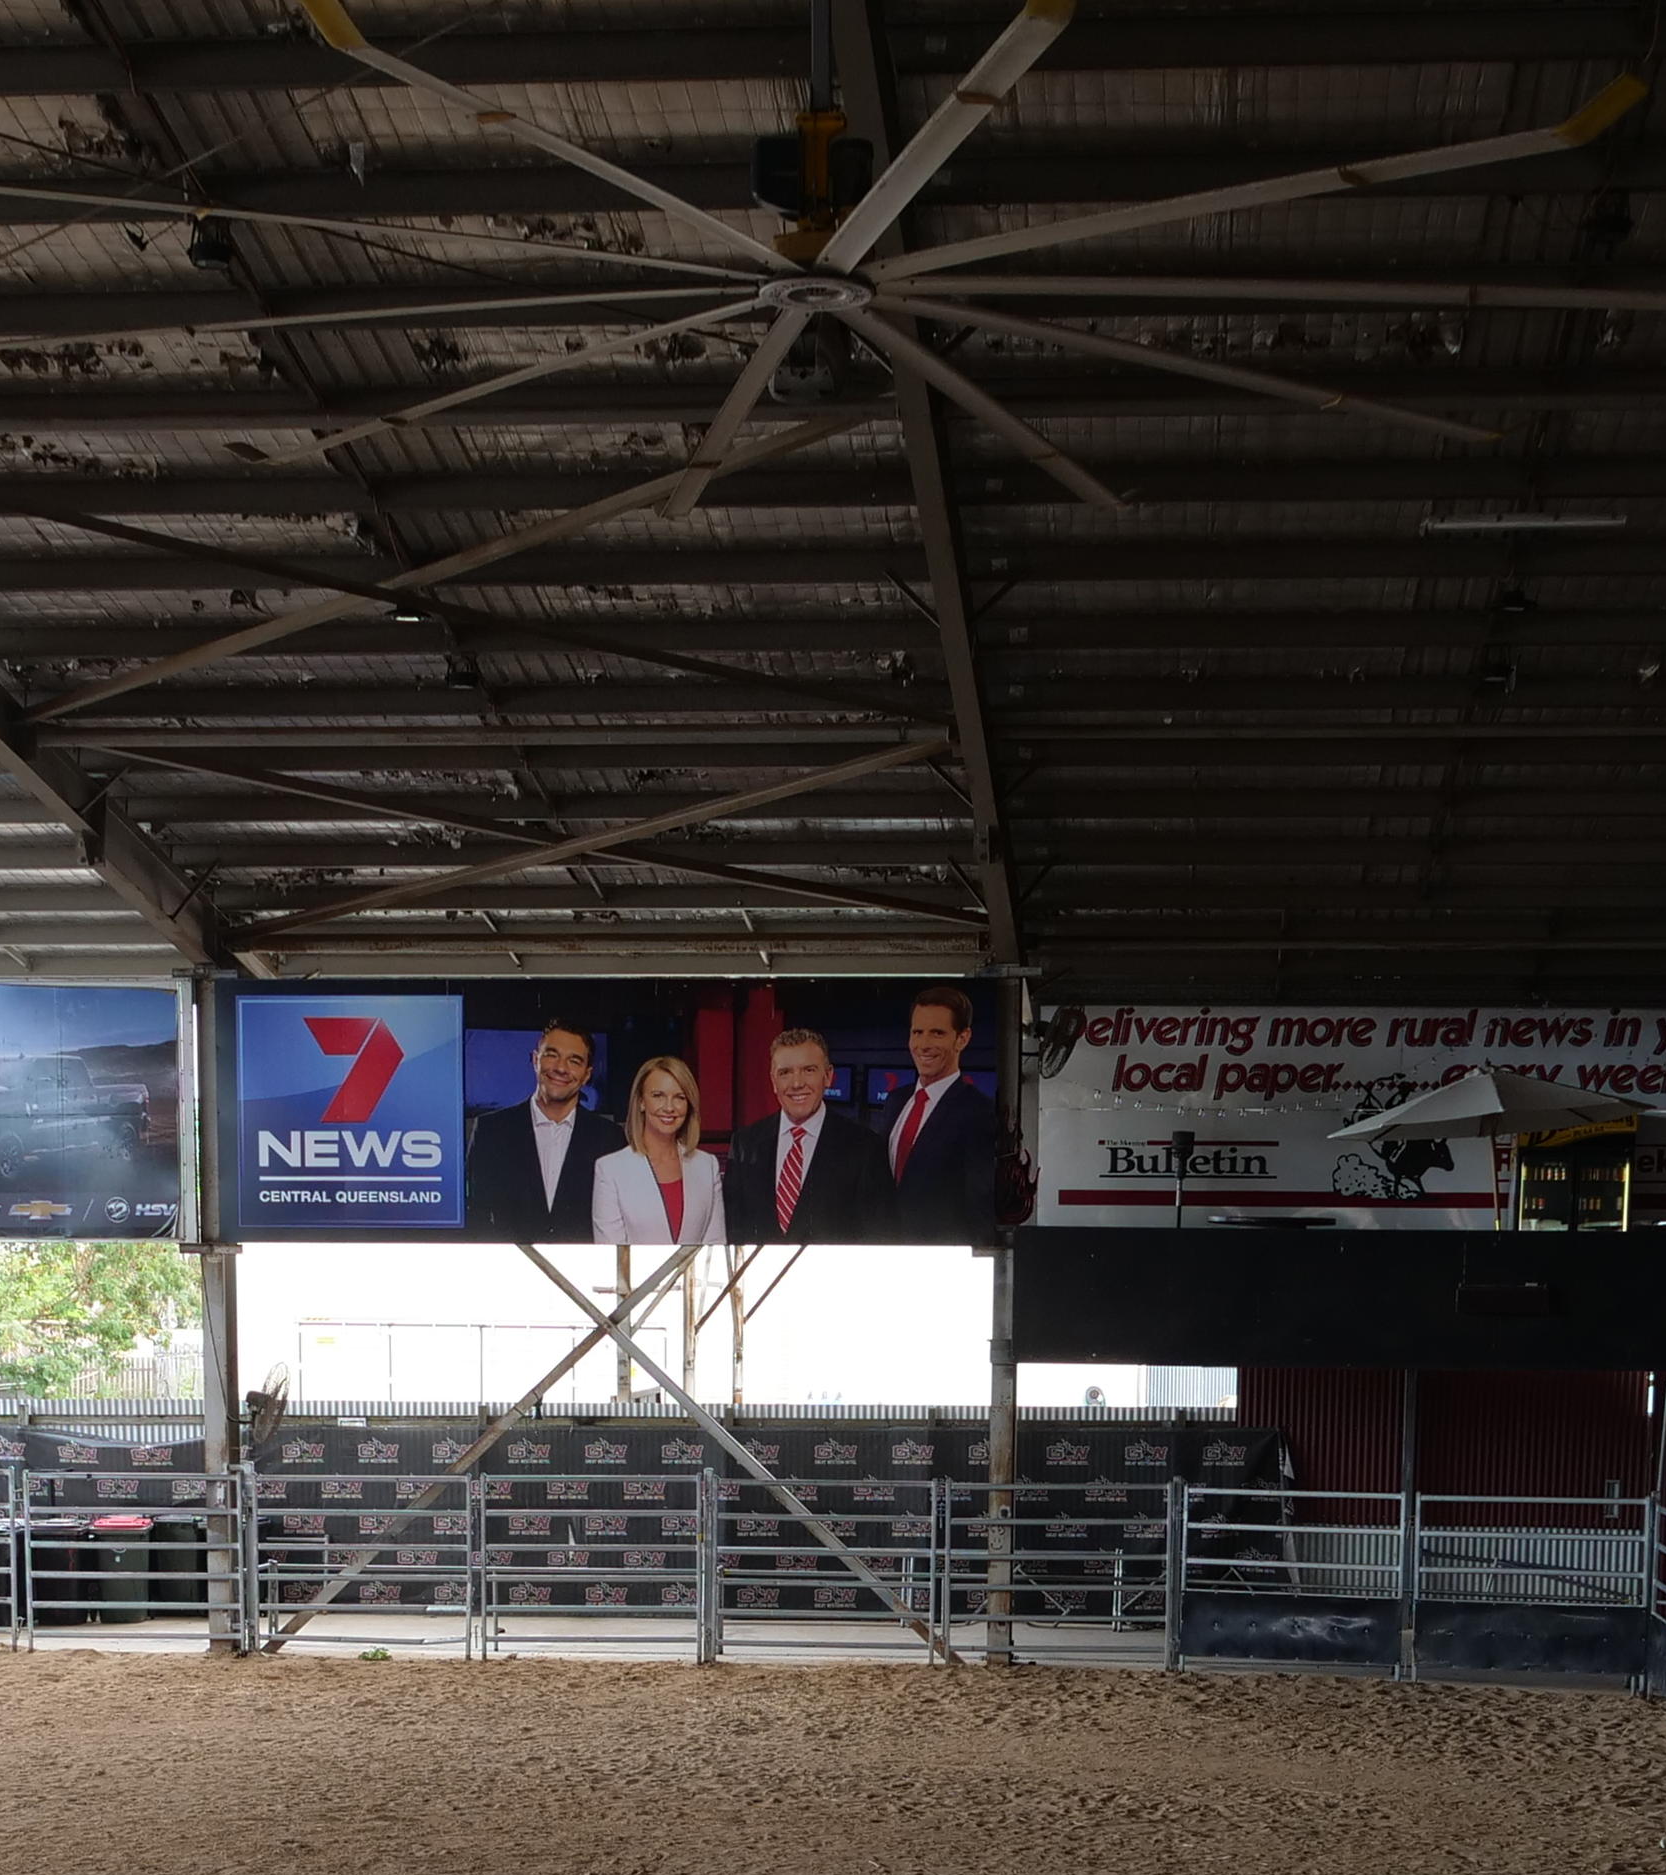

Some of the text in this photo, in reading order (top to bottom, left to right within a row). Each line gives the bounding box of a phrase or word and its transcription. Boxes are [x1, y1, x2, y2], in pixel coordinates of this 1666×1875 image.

[1268, 1016, 1376, 1048] more
[1386, 1008, 1478, 1048] rural
[1484, 1016, 1595, 1048] news
[1603, 1007, 1644, 1048] in
[302, 1016, 405, 1124] 7
[1112, 1055, 1209, 1093] local
[258, 1130, 443, 1168] NEWS
[1105, 1147, 1269, 1176] Buletin
[259, 1190, 443, 1204] CENTRAL QUEENSLAND
